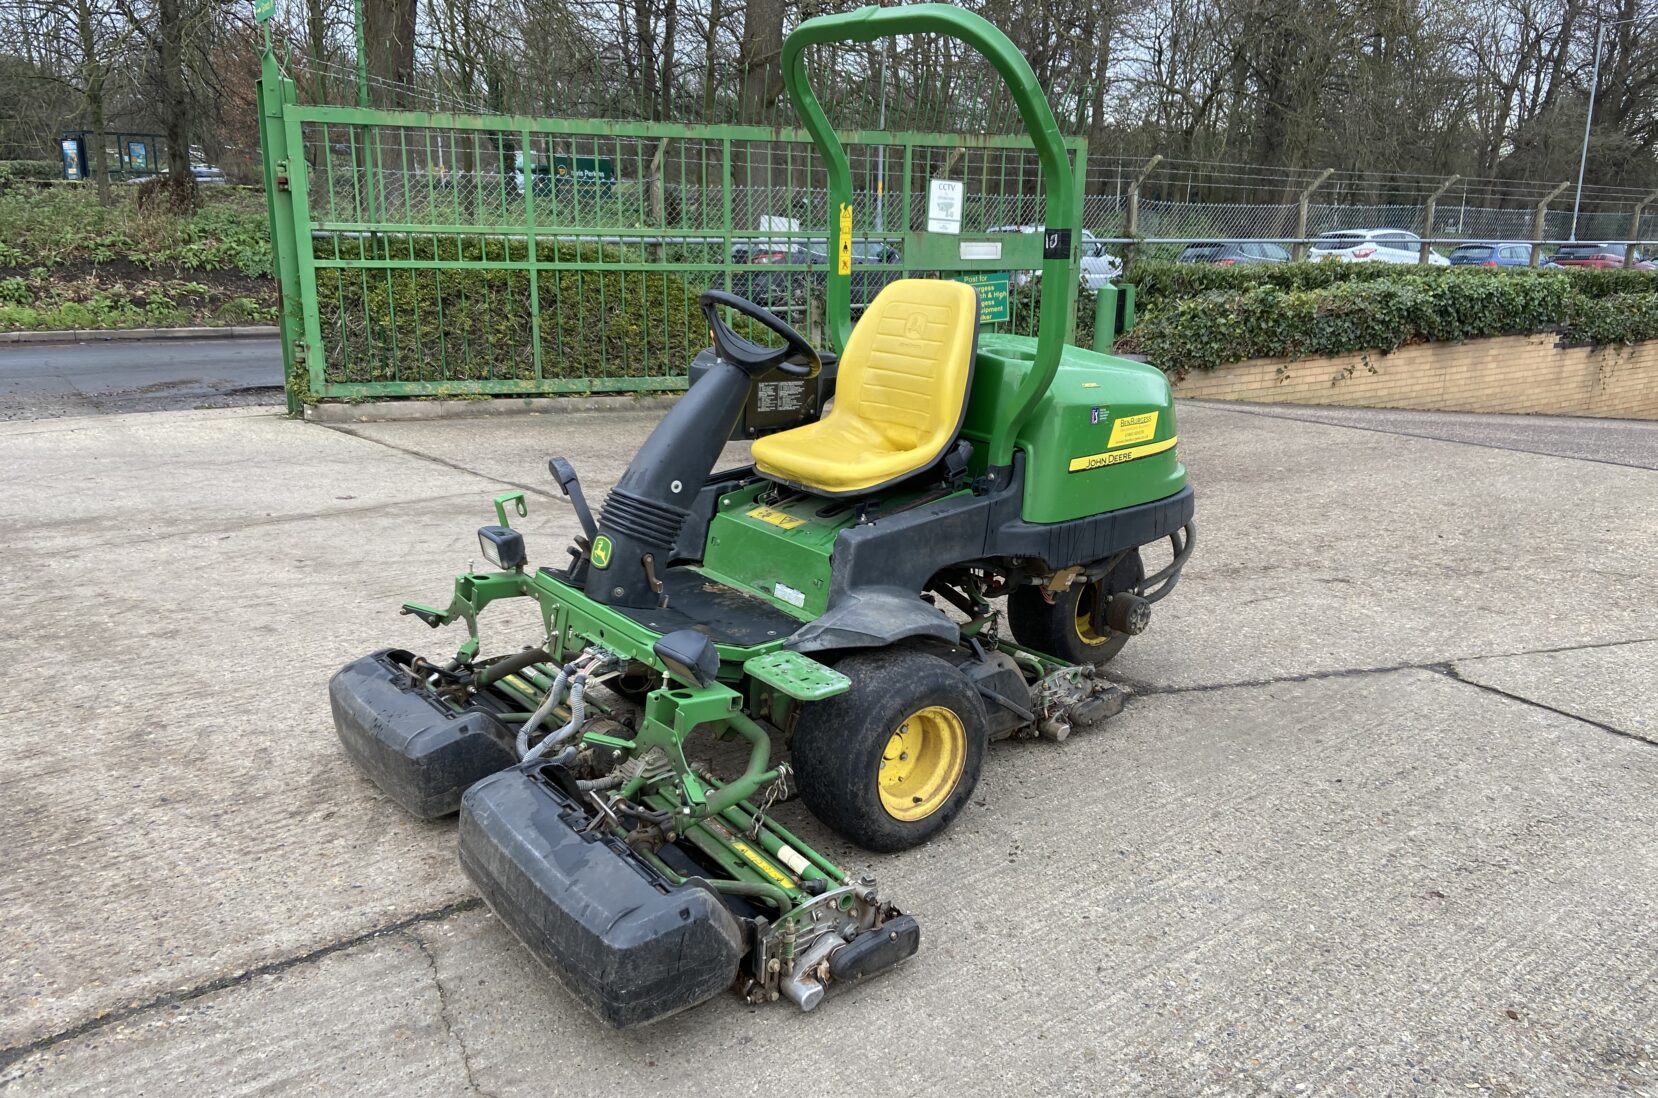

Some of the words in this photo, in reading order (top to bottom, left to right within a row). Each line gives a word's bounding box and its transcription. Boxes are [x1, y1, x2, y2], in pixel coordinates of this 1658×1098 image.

[938, 183, 956, 191] CCTV
[993, 291, 1007, 300] High
[1086, 458, 1107, 469] JOHN
[1108, 451, 1133, 464] DEERE
